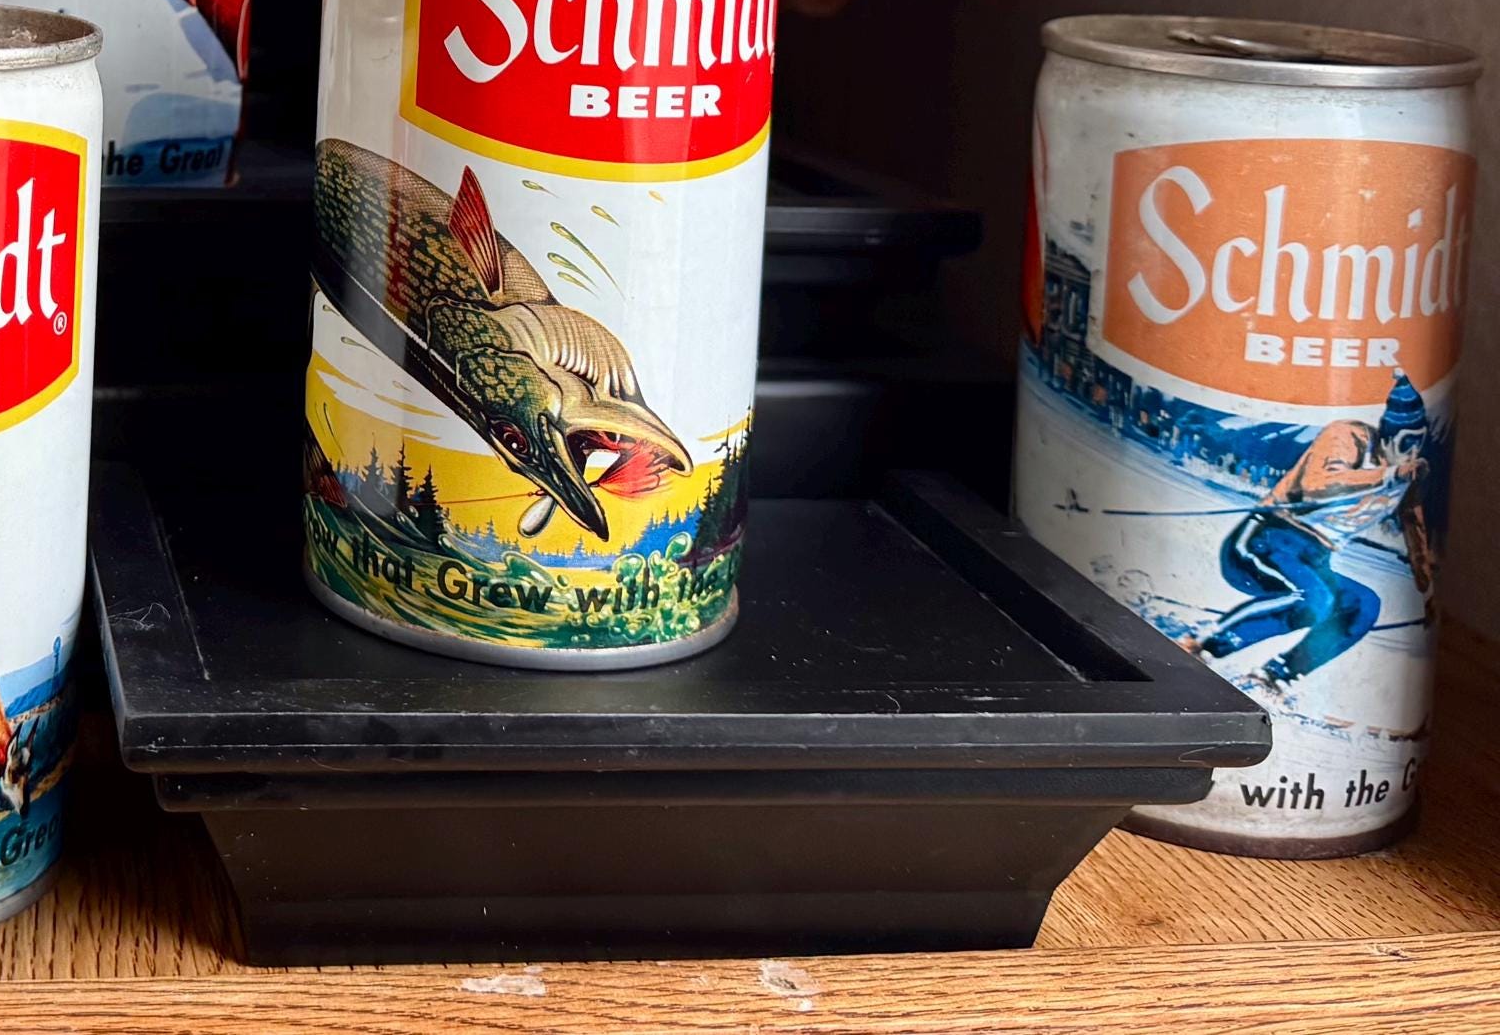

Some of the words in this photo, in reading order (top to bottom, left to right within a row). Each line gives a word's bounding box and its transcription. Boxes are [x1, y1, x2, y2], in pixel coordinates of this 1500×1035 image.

[569, 83, 722, 118] BEER
[102, 140, 145, 176] he
[1127, 165, 1467, 324] Schmidt
[1244, 332, 1401, 367] BEER
[352, 532, 415, 590] that
[437, 559, 553, 614] Grew
[574, 566, 661, 614] with
[1240, 772, 1325, 810] with
[1344, 769, 1390, 808] the
[0, 813, 61, 866] Grea
